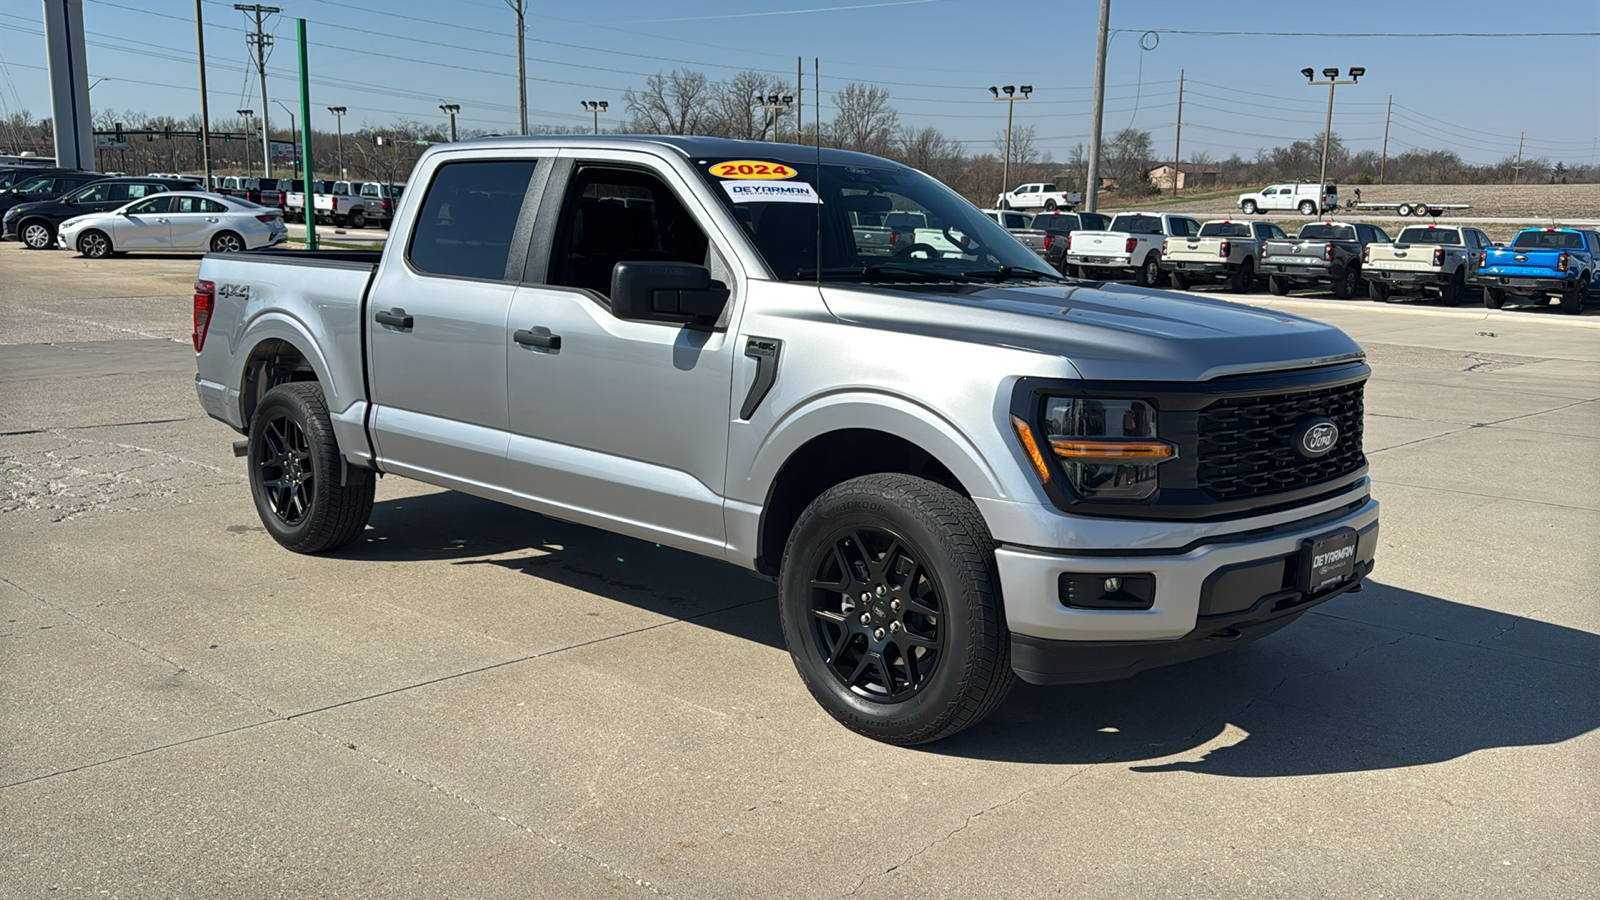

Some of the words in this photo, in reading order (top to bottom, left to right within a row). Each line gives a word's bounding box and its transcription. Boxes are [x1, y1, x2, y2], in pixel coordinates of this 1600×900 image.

[720, 165, 789, 176] 2024
[733, 186, 810, 195] DEYARMAN
[1310, 427, 1333, 448] Ford
[1313, 545, 1355, 568] DEYARMAN
